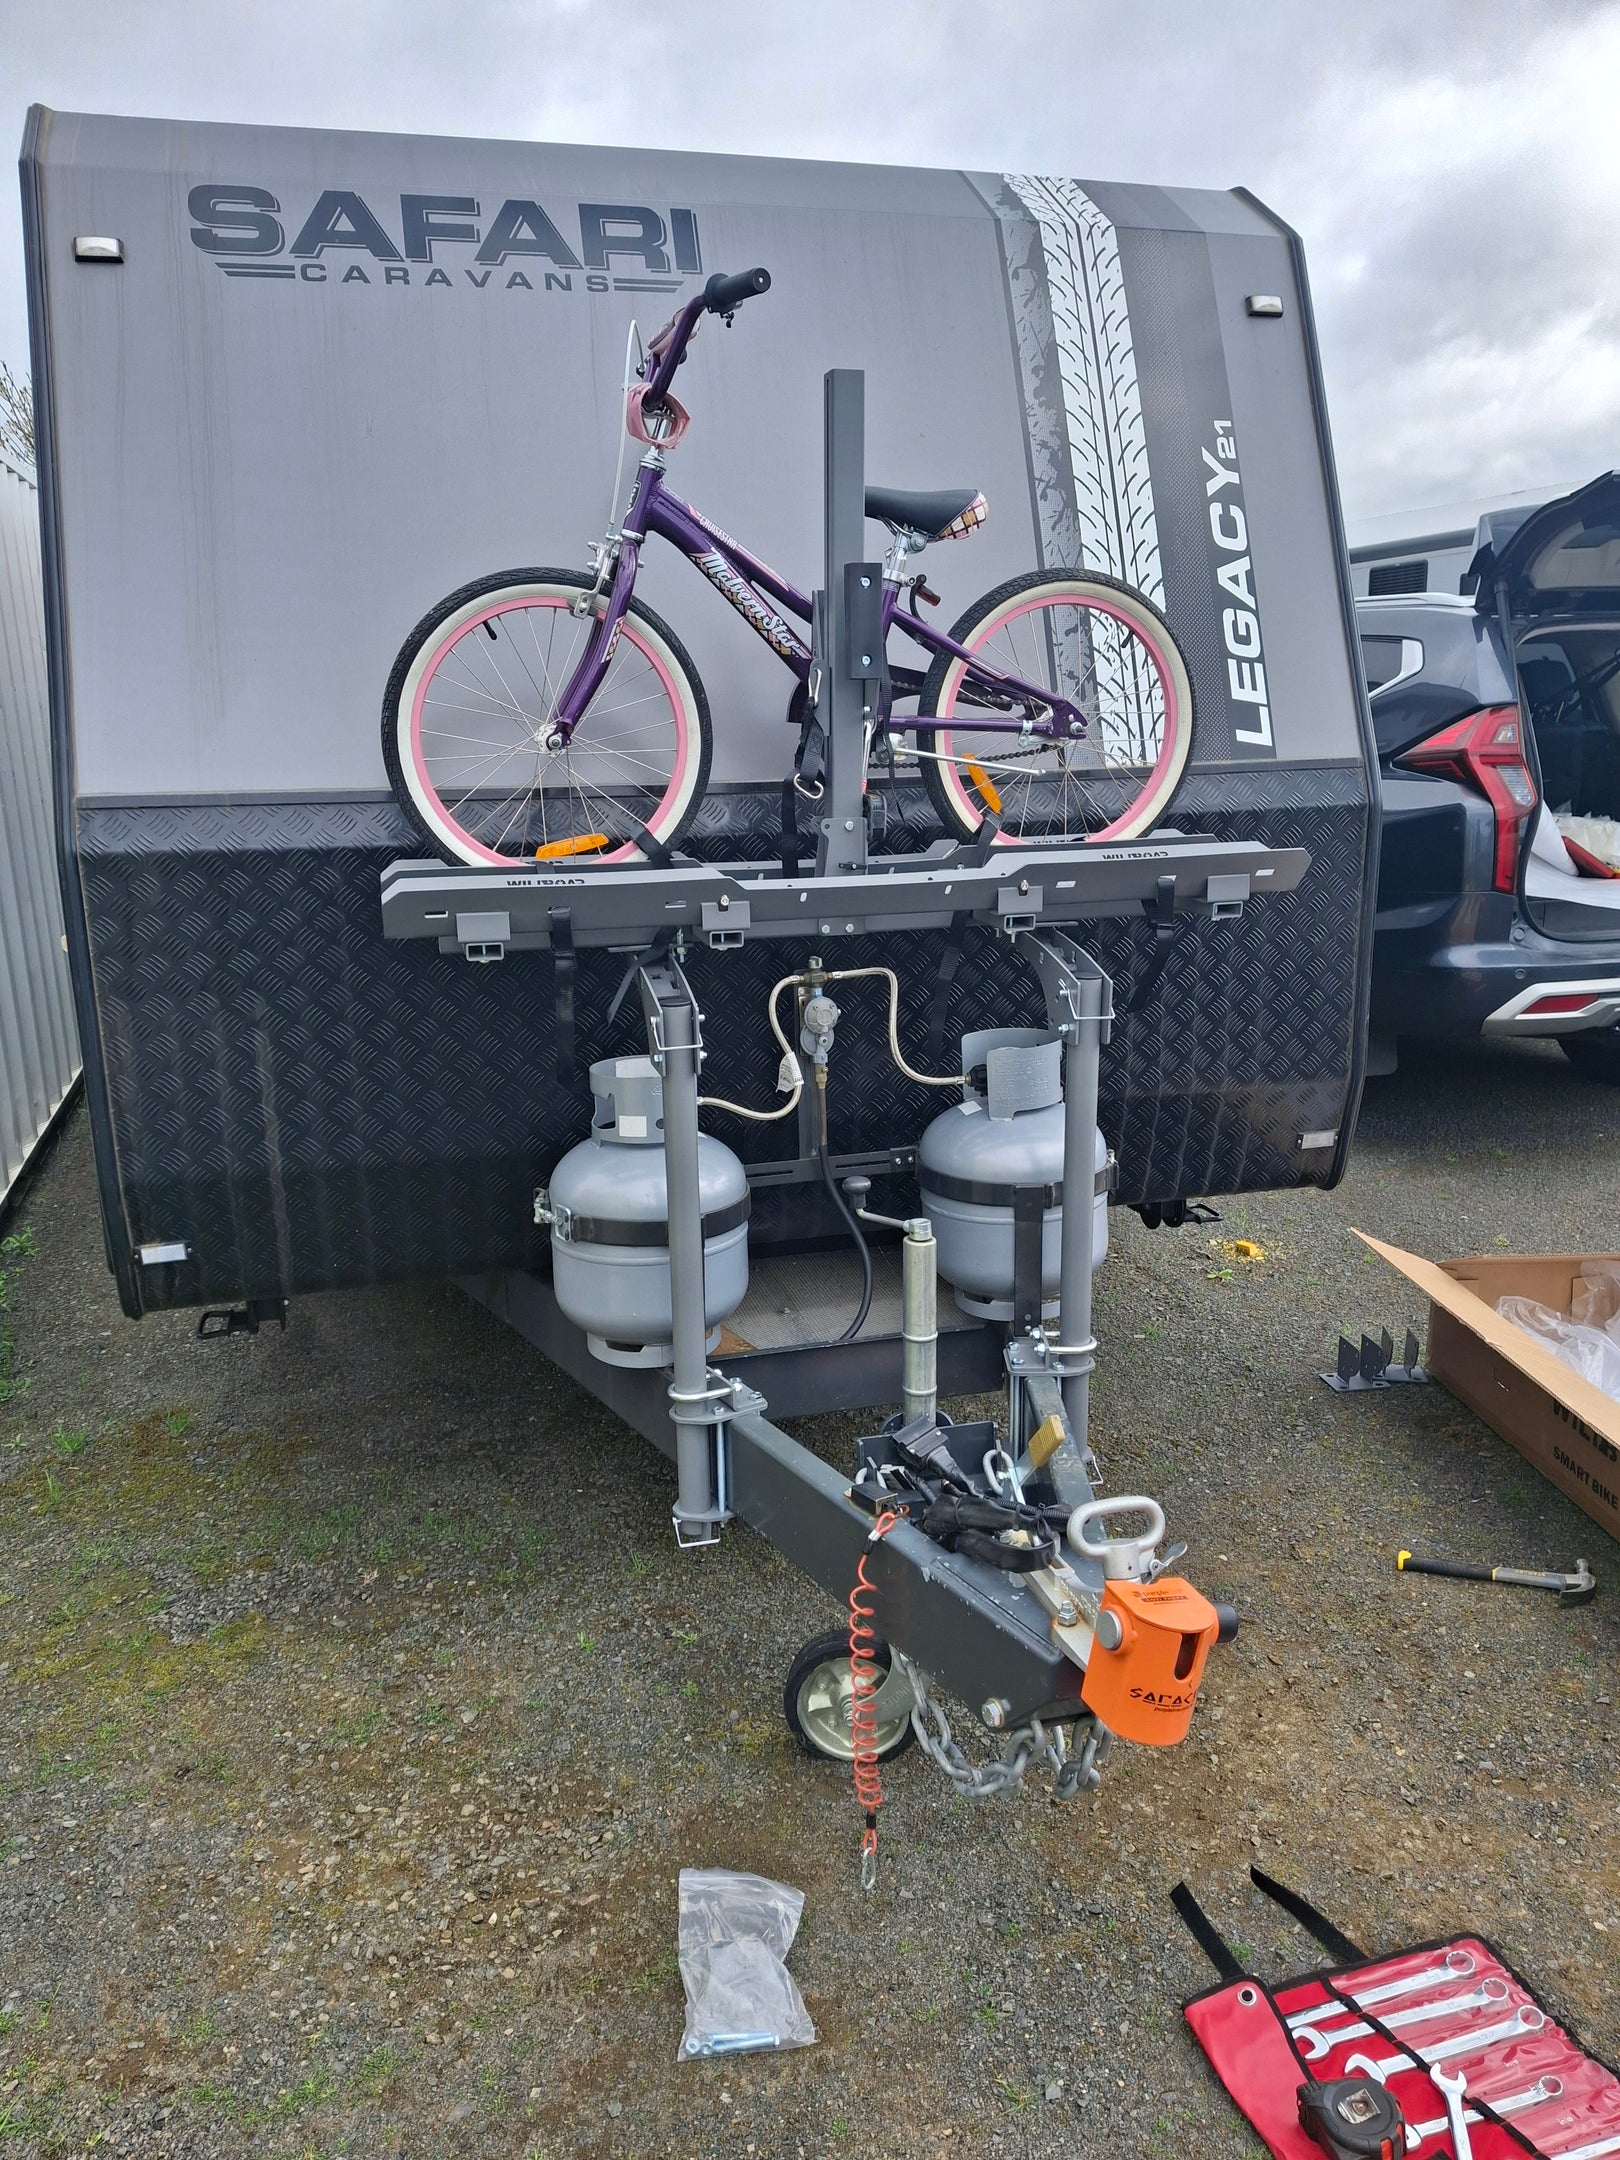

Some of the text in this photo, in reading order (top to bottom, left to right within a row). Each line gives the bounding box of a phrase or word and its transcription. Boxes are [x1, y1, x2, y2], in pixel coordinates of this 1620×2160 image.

[187, 184, 703, 275] SAFARI
[300, 263, 609, 293] CARAVANS
[701, 547, 802, 653] Malvern Star
[1201, 420, 1273, 746] LEGACY 21
[1553, 1446, 1619, 1510] SMART BIKE
